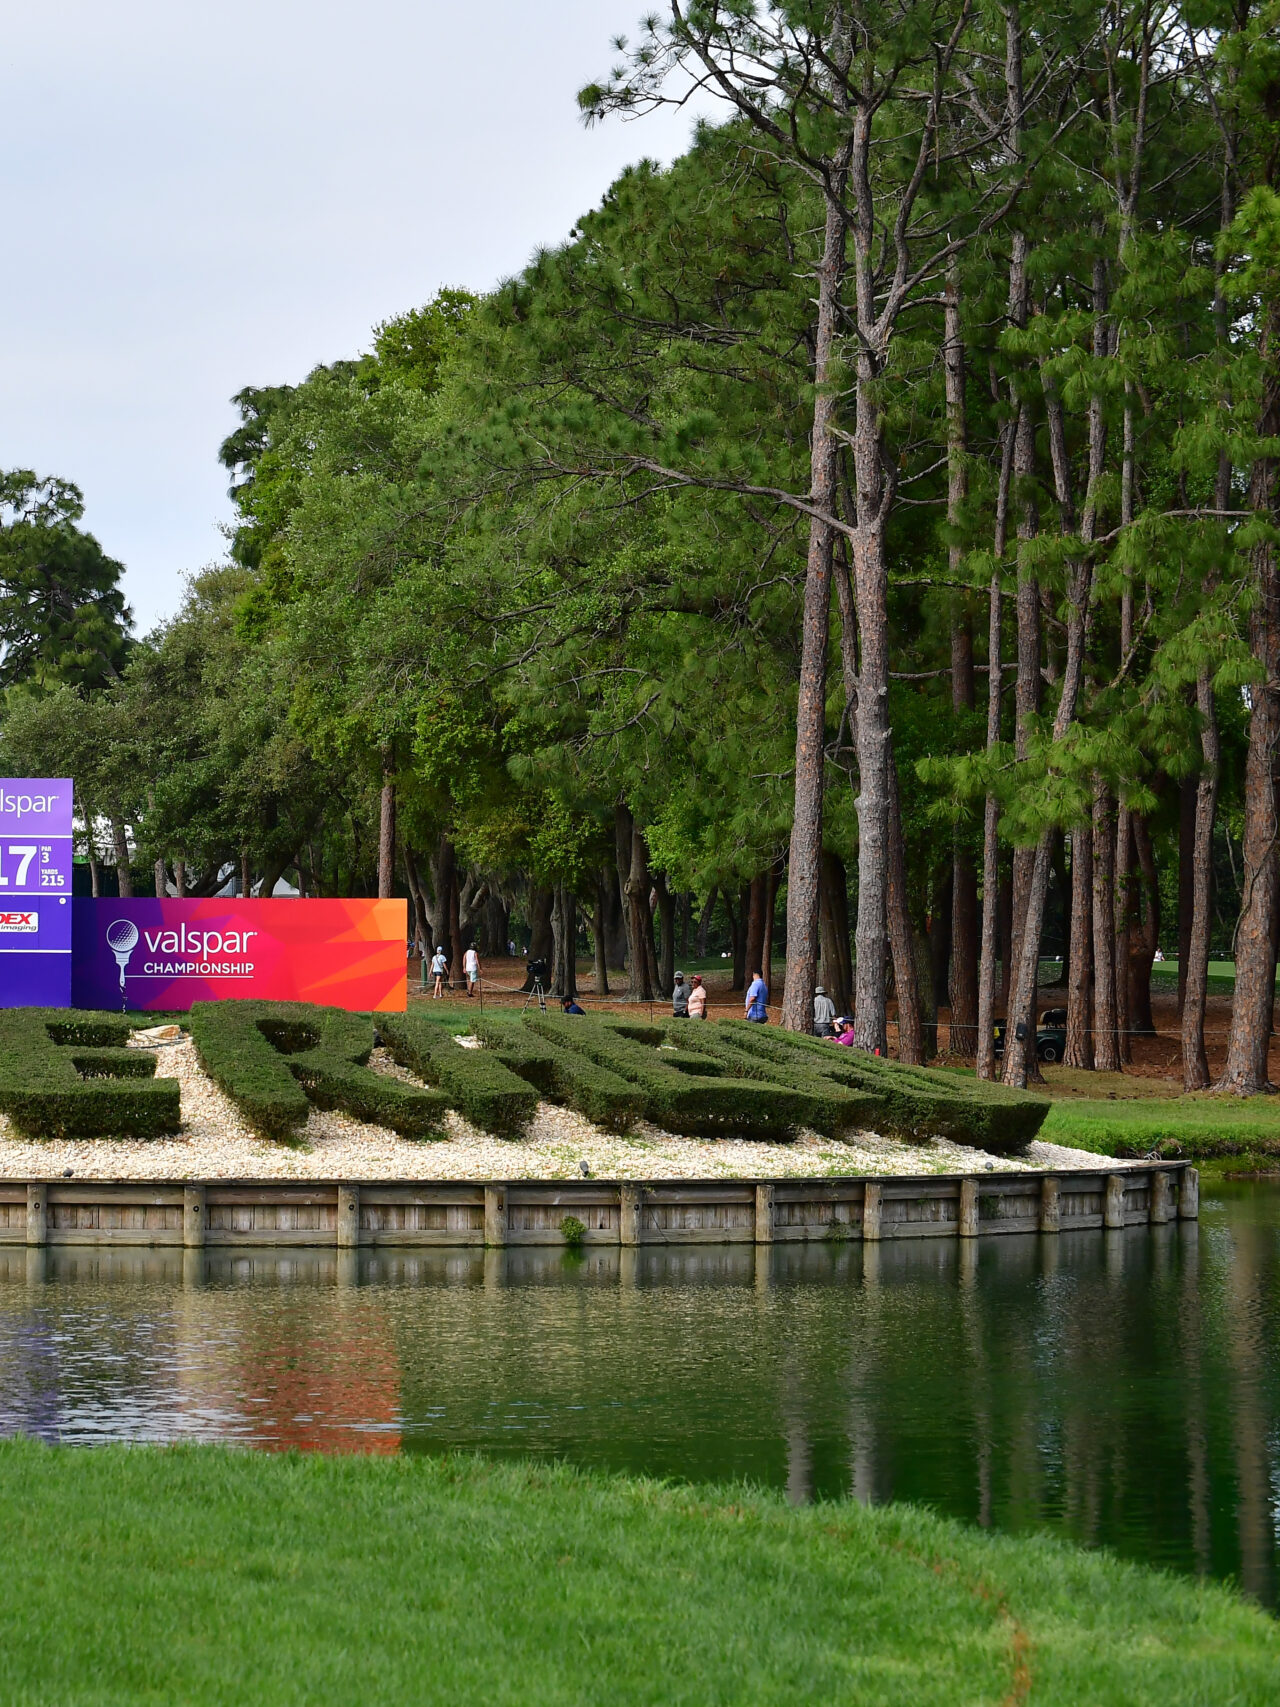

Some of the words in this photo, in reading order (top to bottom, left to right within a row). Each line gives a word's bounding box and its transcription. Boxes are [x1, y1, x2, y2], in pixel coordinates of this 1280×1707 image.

[41, 852, 50, 863] 3
[41, 875, 65, 886] 215
[144, 923, 255, 960] valspar
[144, 962, 254, 974] CHAMPIONSHIP
